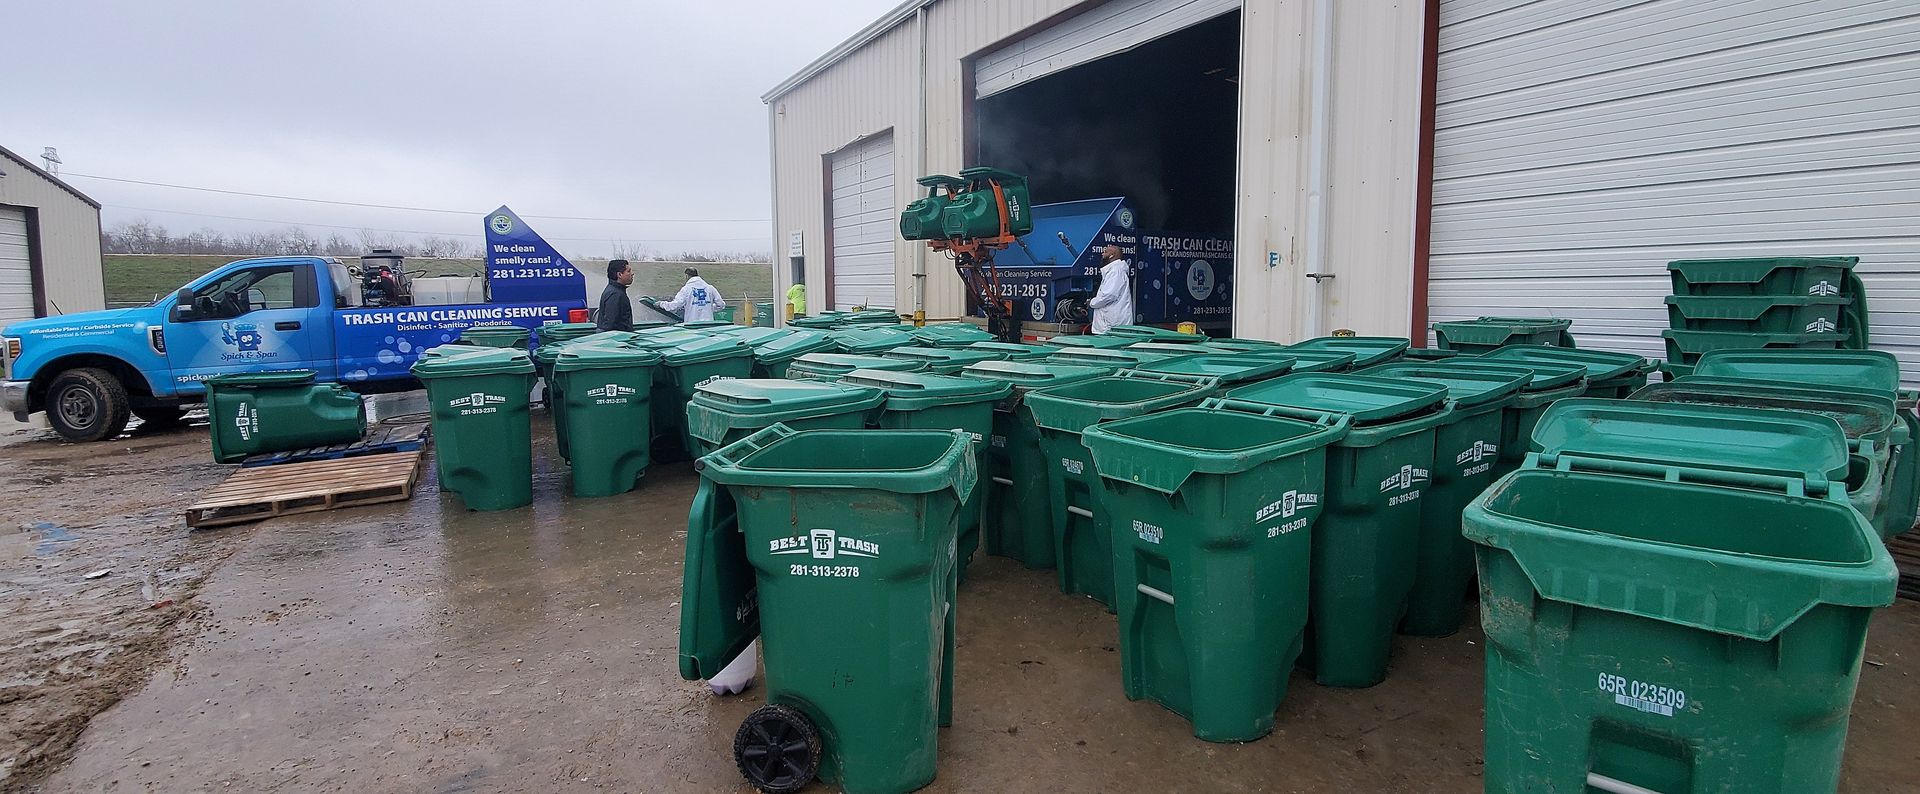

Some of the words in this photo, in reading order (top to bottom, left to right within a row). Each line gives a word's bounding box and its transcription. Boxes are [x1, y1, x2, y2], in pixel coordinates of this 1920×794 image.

[1104, 233, 1116, 242] We
[1117, 234, 1136, 243] clean
[1147, 237, 1180, 250] TRASH
[1183, 239, 1203, 250] CAN
[493, 244, 509, 253] We
[510, 244, 535, 253] clean
[1121, 246, 1136, 254] ans!
[495, 256, 526, 266] smelly
[527, 256, 551, 264] cans!
[492, 268, 574, 279] 281.231.2815
[1004, 270, 1029, 279] Cleaning
[1030, 270, 1052, 278] Service
[342, 313, 394, 326] TRASH
[397, 311, 428, 323] CAN
[430, 308, 501, 322] CLEANING
[504, 306, 559, 318] SERVICE
[29, 326, 62, 335] Affordable
[84, 323, 111, 331] Curbside
[397, 323, 433, 332] Disinfect
[438, 321, 469, 329] Sanitize
[474, 319, 513, 328] Deodorize
[42, 331, 74, 339] Residential
[80, 329, 114, 337] Commercial
[220, 351, 245, 362] Spick
[246, 351, 253, 359] &
[256, 350, 278, 361] Span
[587, 387, 606, 396] BEST
[450, 396, 471, 405] BEST
[1456, 447, 1474, 463] BEST
[1380, 472, 1400, 490] BEST
[1256, 499, 1282, 521] BEST
[1297, 493, 1318, 503] TRASH
[1132, 519, 1144, 534] 65R
[1267, 517, 1307, 538] 281-313-2378
[769, 535, 808, 551] BEST
[838, 536, 880, 555] TRASH
[790, 564, 860, 578] 281-313-2378
[1598, 672, 1627, 696] 65R
[1630, 680, 1685, 710] 023509
